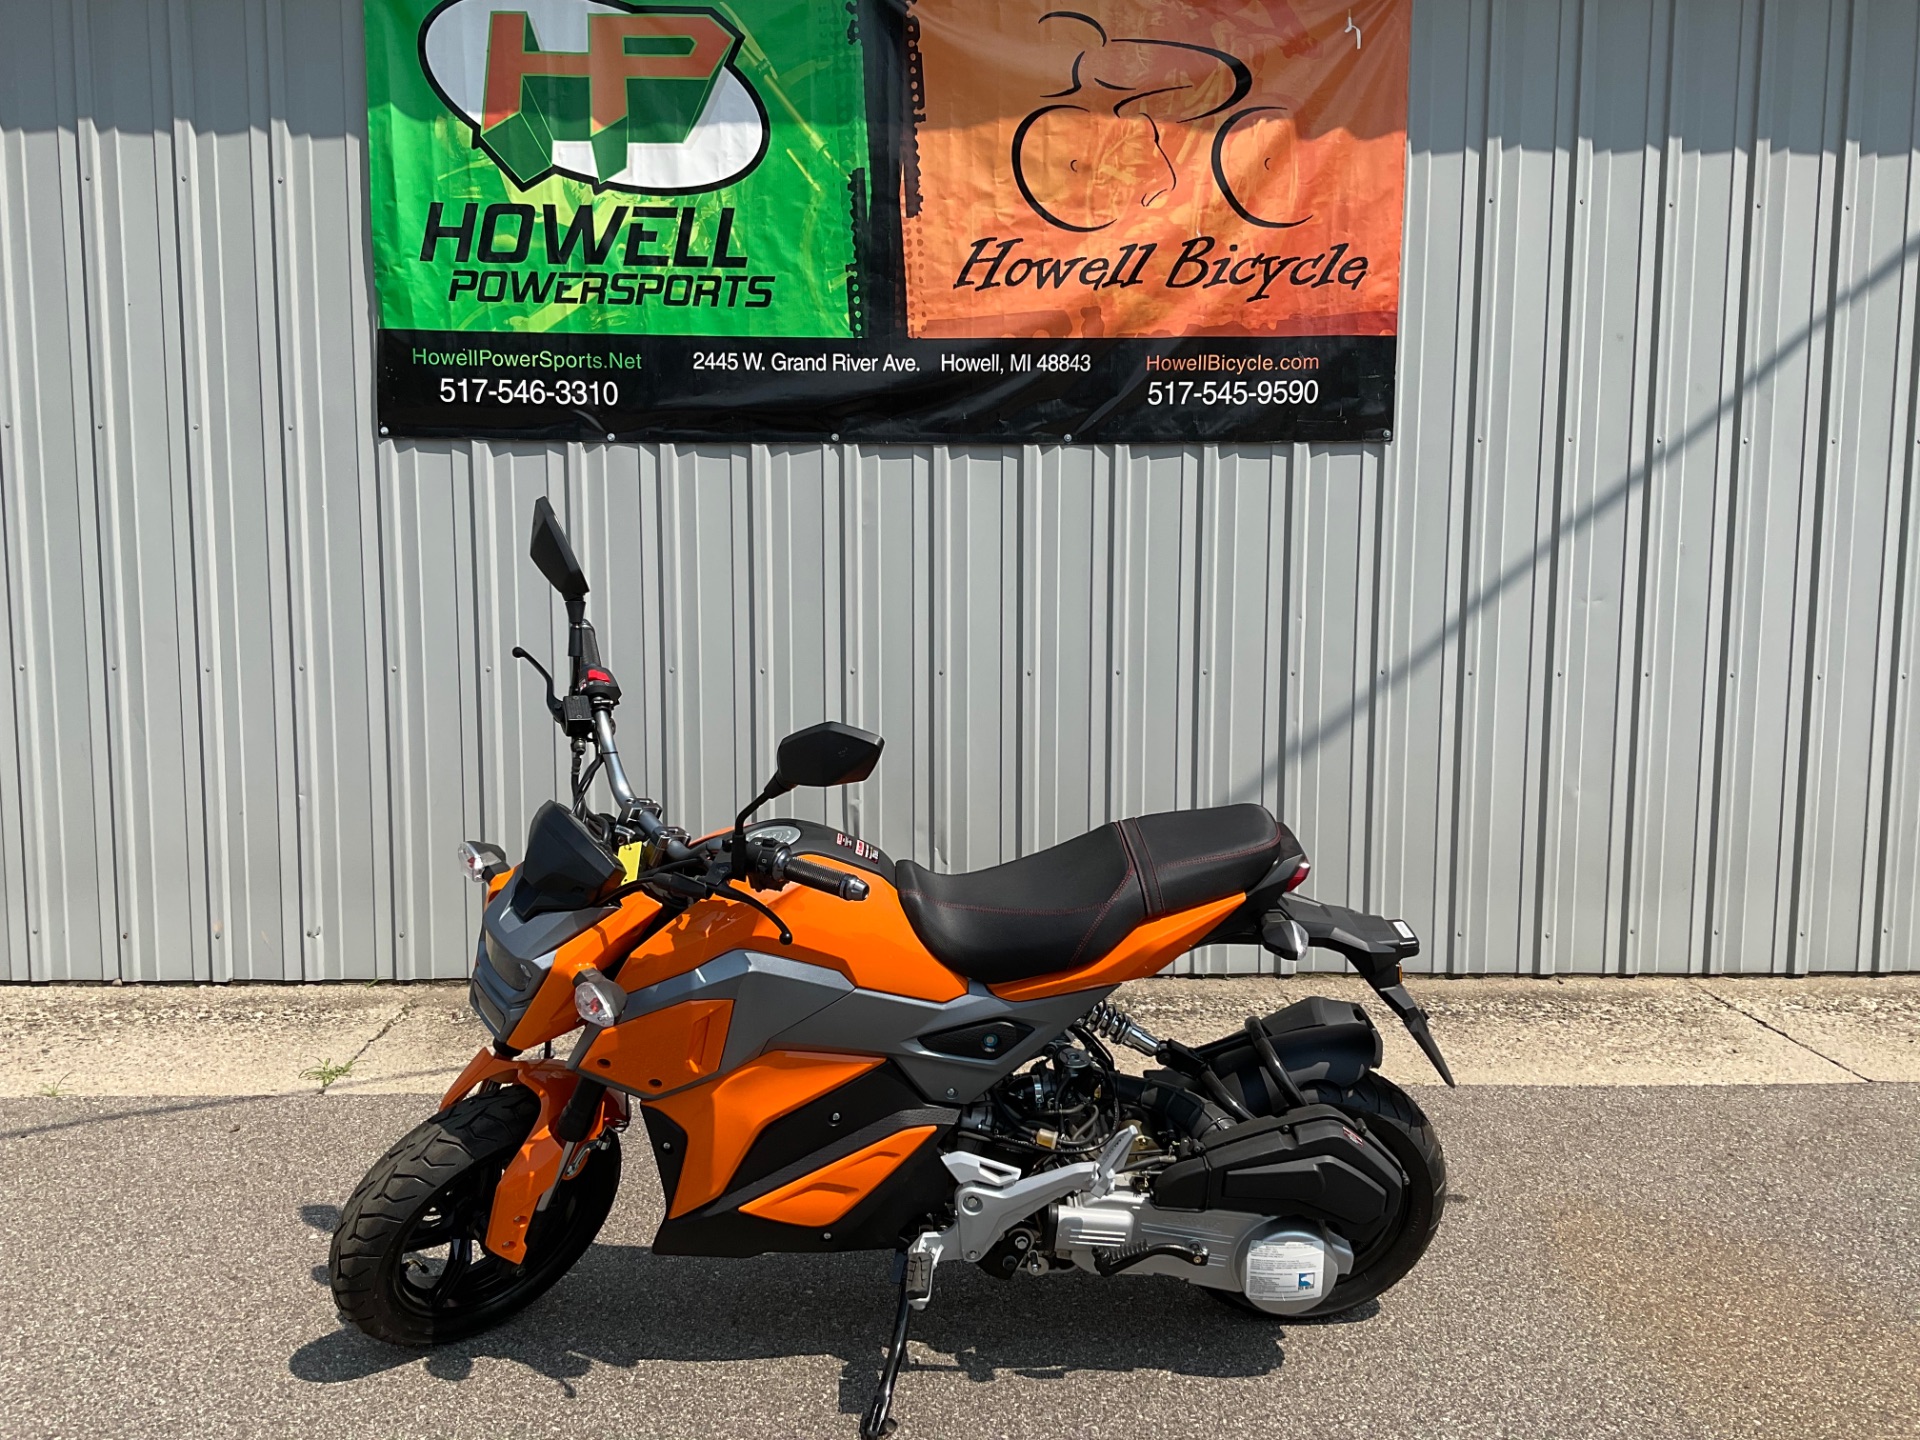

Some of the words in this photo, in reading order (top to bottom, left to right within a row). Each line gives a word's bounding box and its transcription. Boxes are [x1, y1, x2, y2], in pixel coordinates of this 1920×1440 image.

[482, 10, 736, 178] HP
[419, 202, 748, 268] HOWELL
[953, 236, 1158, 292] Howell
[1165, 236, 1369, 303] Bicycle
[448, 270, 776, 308] POWERSPORTS
[412, 348, 642, 372] HowellPowerSports.Net
[692, 352, 739, 371] 2445
[742, 353, 766, 371] W.
[771, 353, 827, 372] Grand
[832, 353, 879, 372] River
[882, 354, 921, 372] Ave.
[941, 353, 1004, 375] Howell,
[1010, 353, 1031, 372] MI
[1036, 353, 1091, 372] 48843
[1146, 354, 1319, 375] HowellBicycle.com
[439, 378, 619, 406] 517-546-3310
[1147, 380, 1319, 406] 517-545-9590
